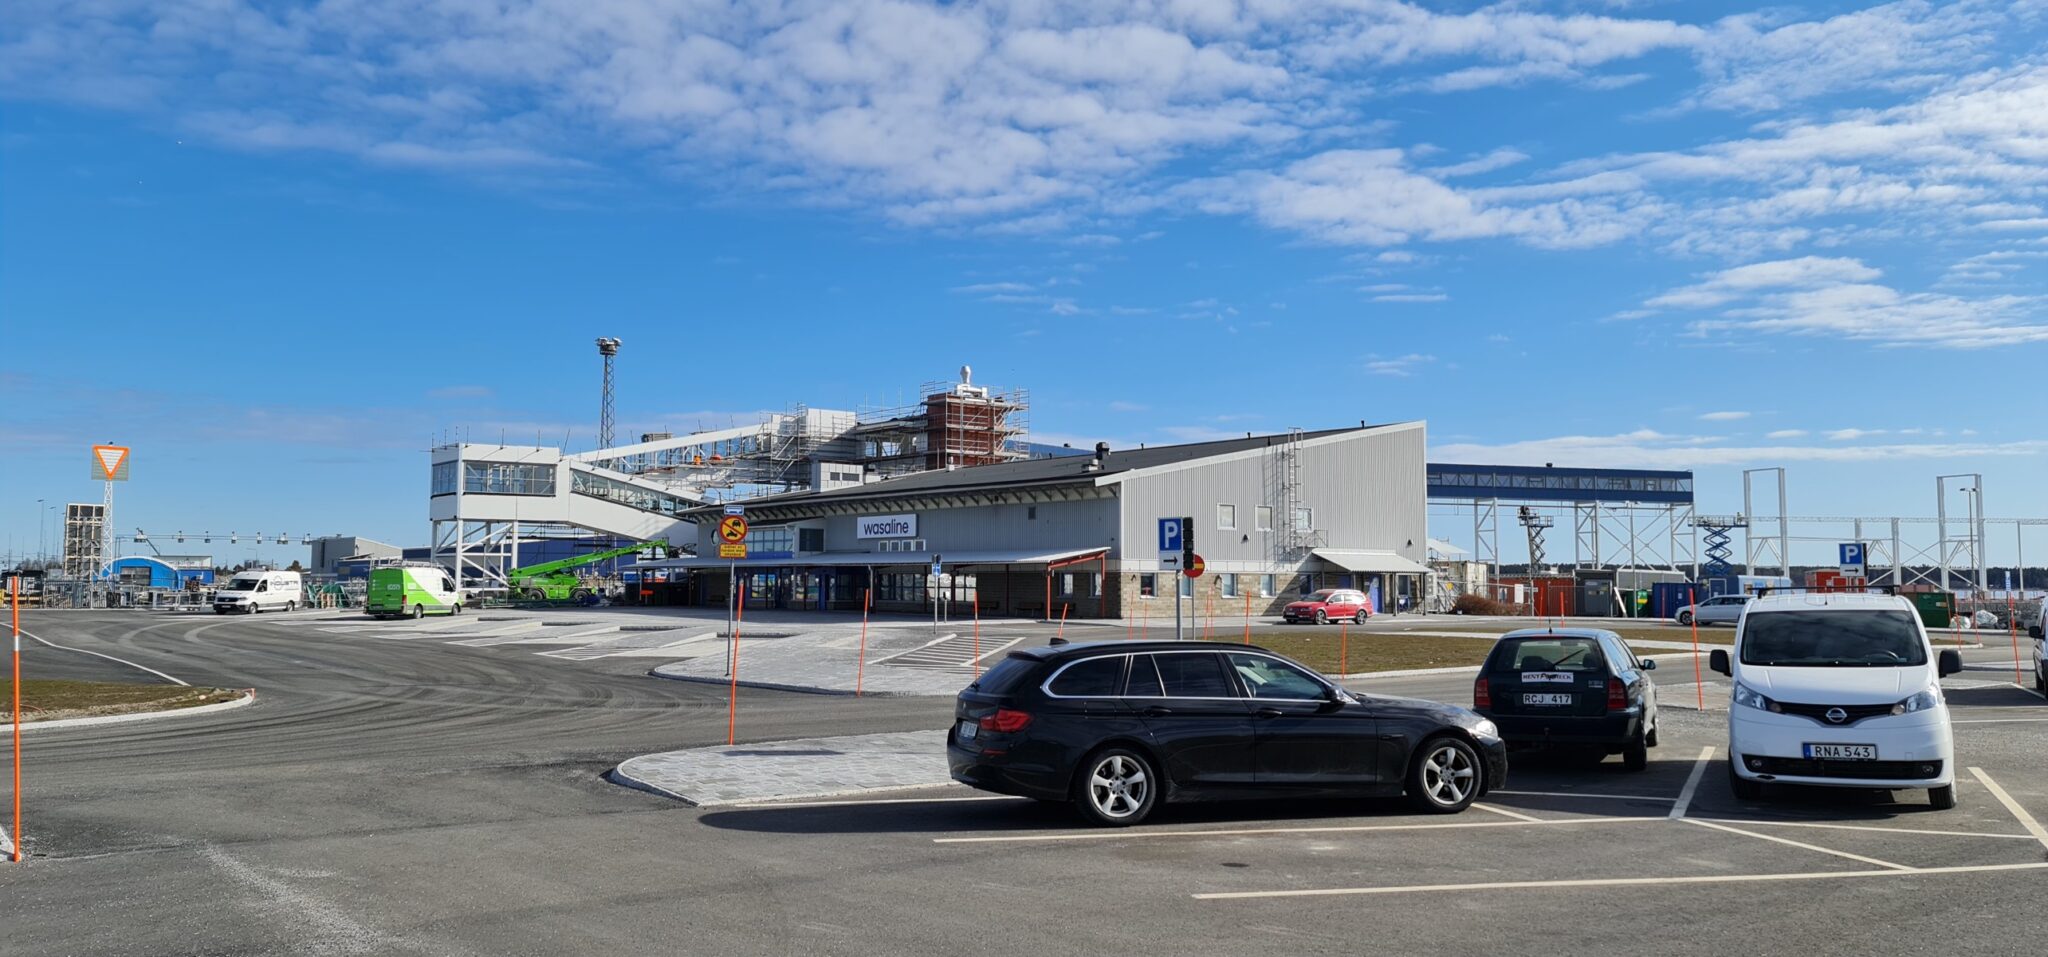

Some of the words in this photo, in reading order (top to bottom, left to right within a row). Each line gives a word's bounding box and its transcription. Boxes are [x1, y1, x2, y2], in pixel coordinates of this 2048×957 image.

[864, 519, 909, 535] wasaline
[1164, 521, 1178, 549] P
[1845, 545, 1859, 563] P
[1524, 695, 1544, 703] RCJ
[1551, 695, 1570, 703] 417
[1815, 746, 1840, 757] RNA
[1844, 747, 1871, 758] 543
